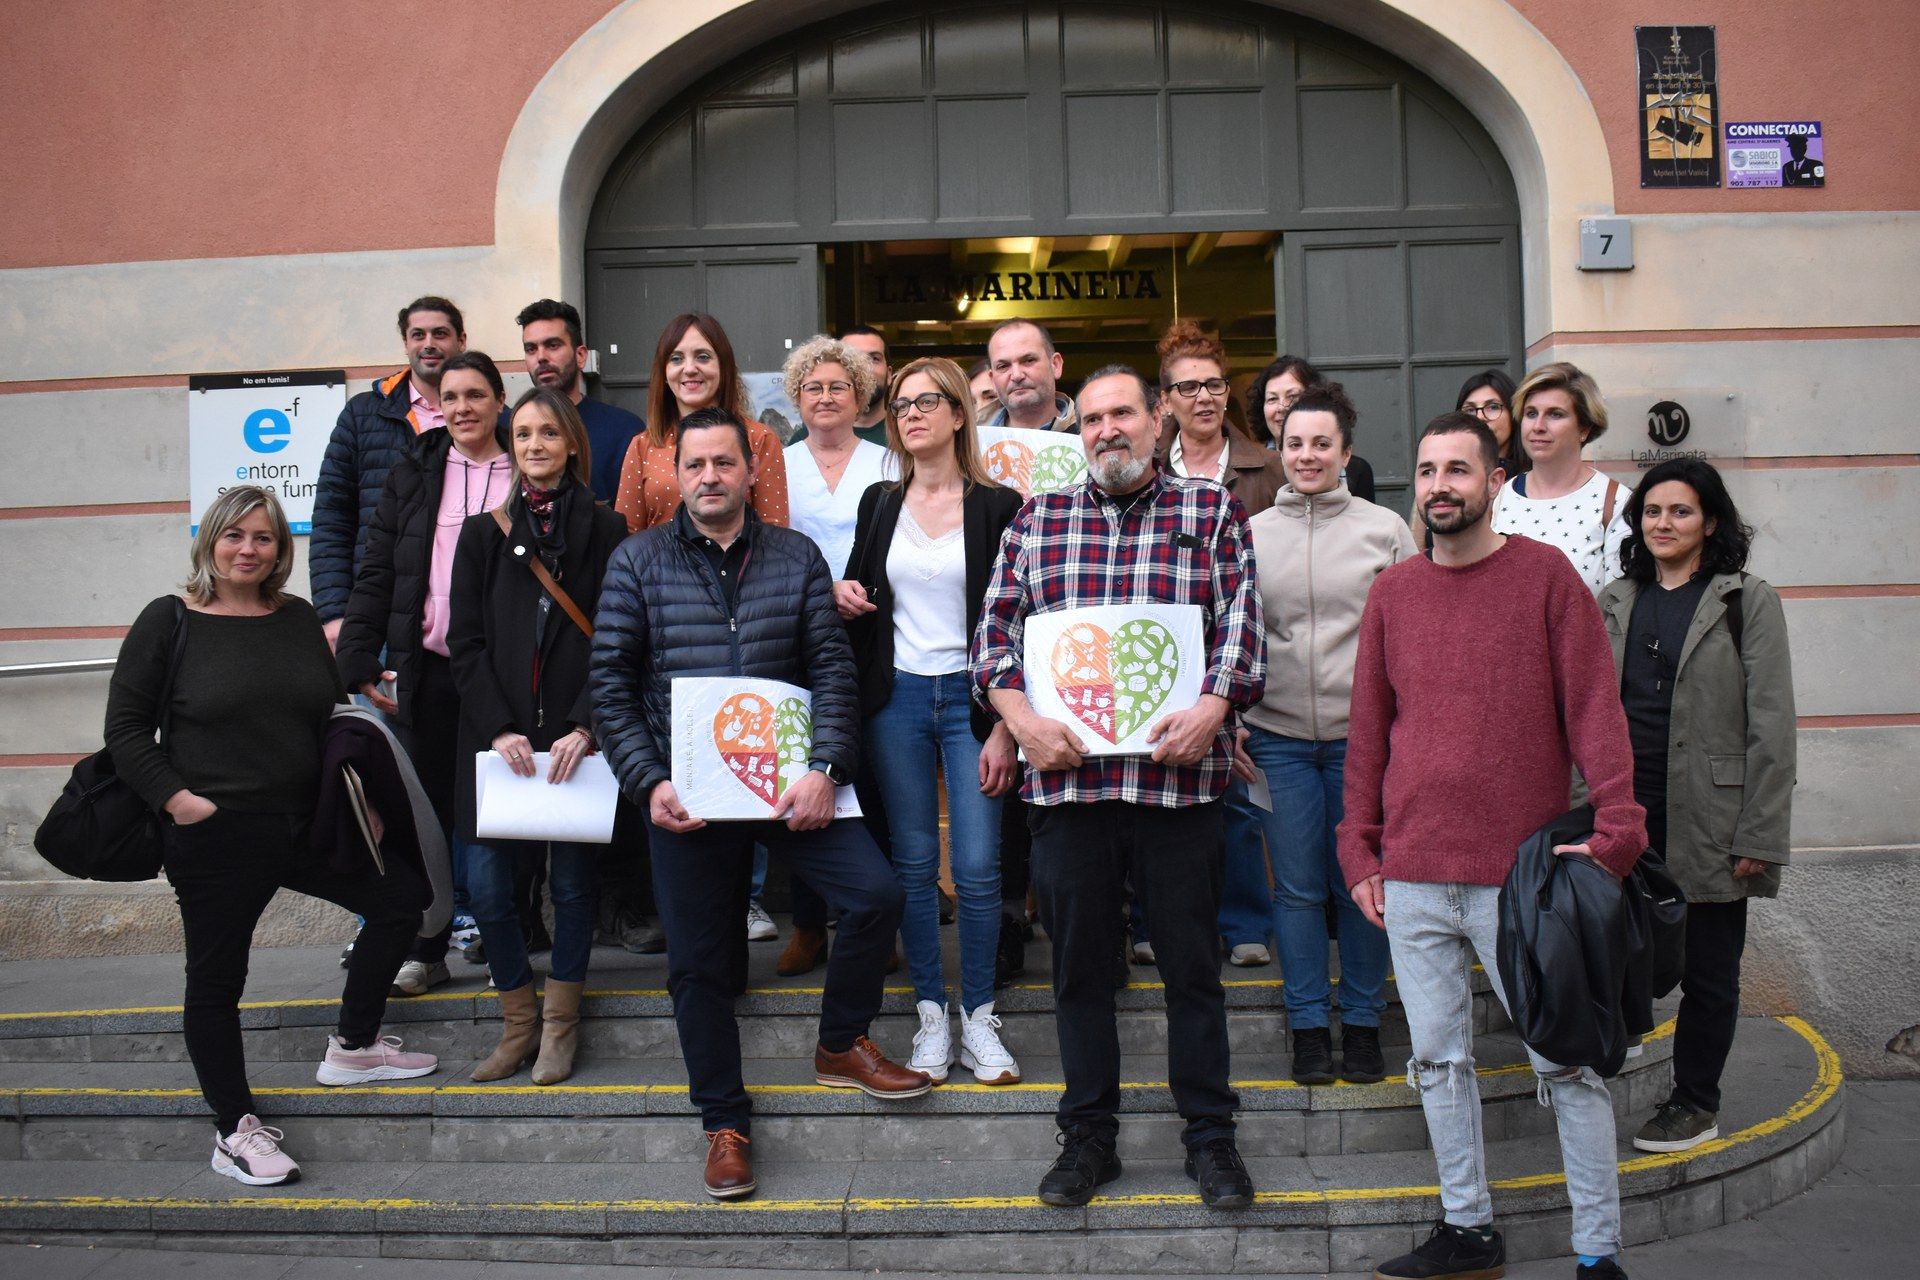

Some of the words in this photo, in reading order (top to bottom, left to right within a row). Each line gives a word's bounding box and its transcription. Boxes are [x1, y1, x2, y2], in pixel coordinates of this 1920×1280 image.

[1729, 124, 1817, 136] CONNECTADA
[1749, 151, 1778, 160] SABICO
[1599, 234, 1613, 255] 7
[267, 376, 290, 384] fumis!
[236, 462, 299, 480] entorn
